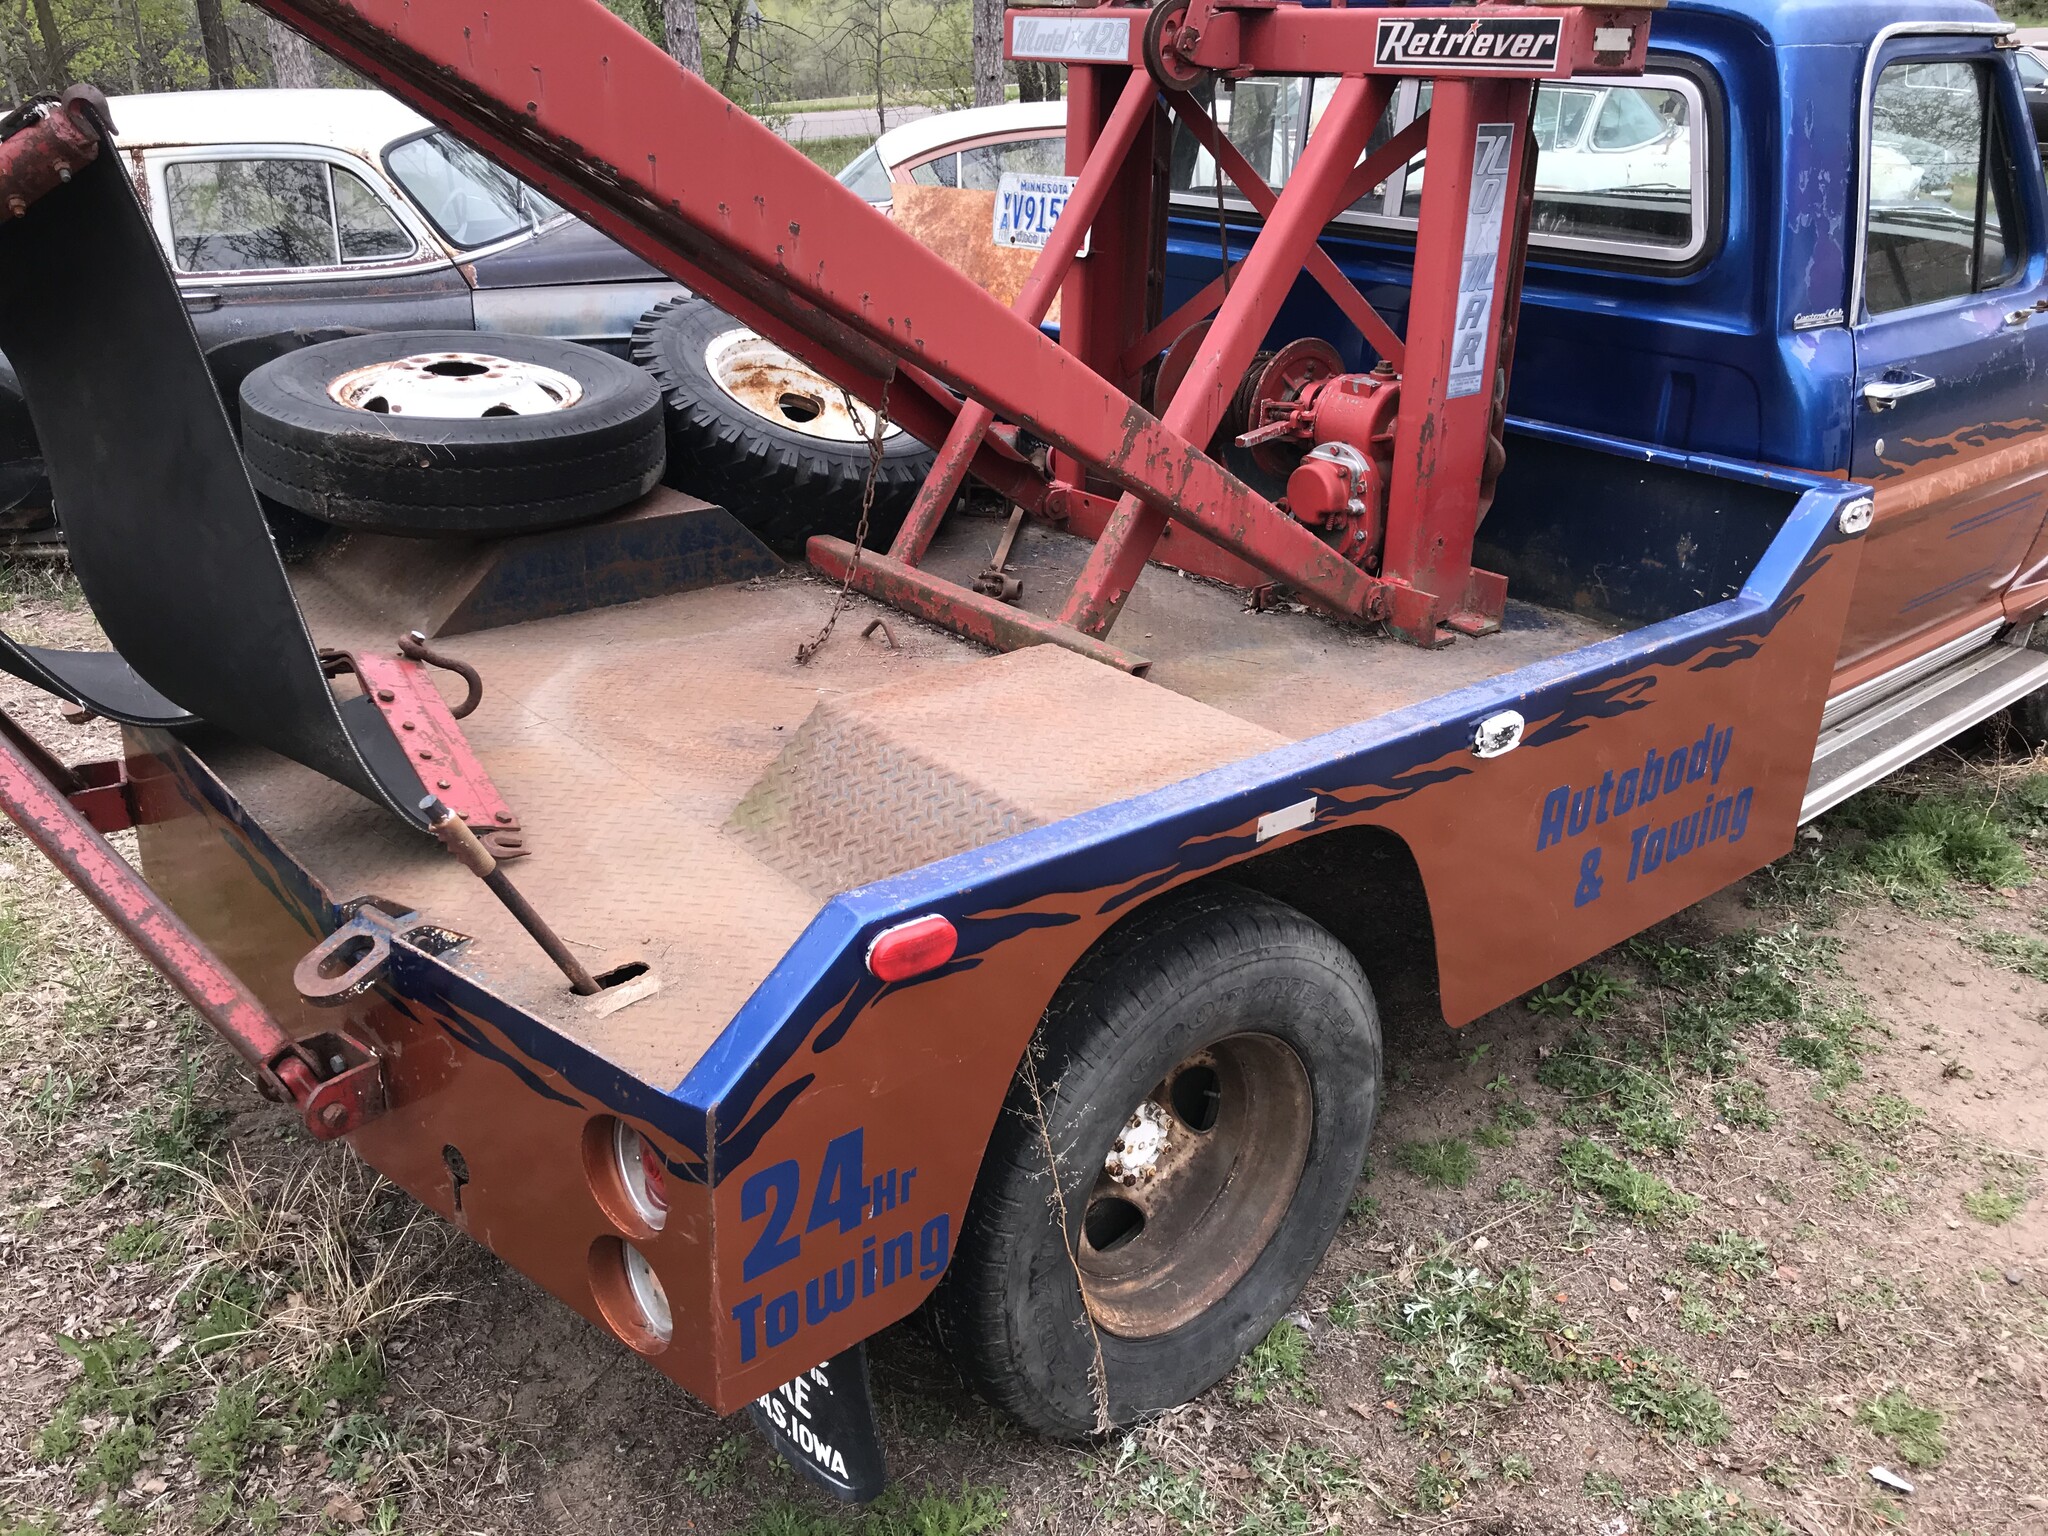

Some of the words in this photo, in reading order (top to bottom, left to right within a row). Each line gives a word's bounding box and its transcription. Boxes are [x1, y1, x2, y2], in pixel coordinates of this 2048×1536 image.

[1014, 20, 1071, 53] Model
[1081, 22, 1128, 55] 428
[1379, 20, 1555, 61] Retriever
[1013, 193, 1068, 233] V915
[1021, 181, 1068, 195] MINNESOTA
[1536, 723, 1734, 851] Autobody
[1574, 847, 1603, 908] &
[1627, 786, 1754, 883] Towing
[1130, 976, 1354, 1083] GOODYEAR
[732, 1213, 949, 1364] Towing
